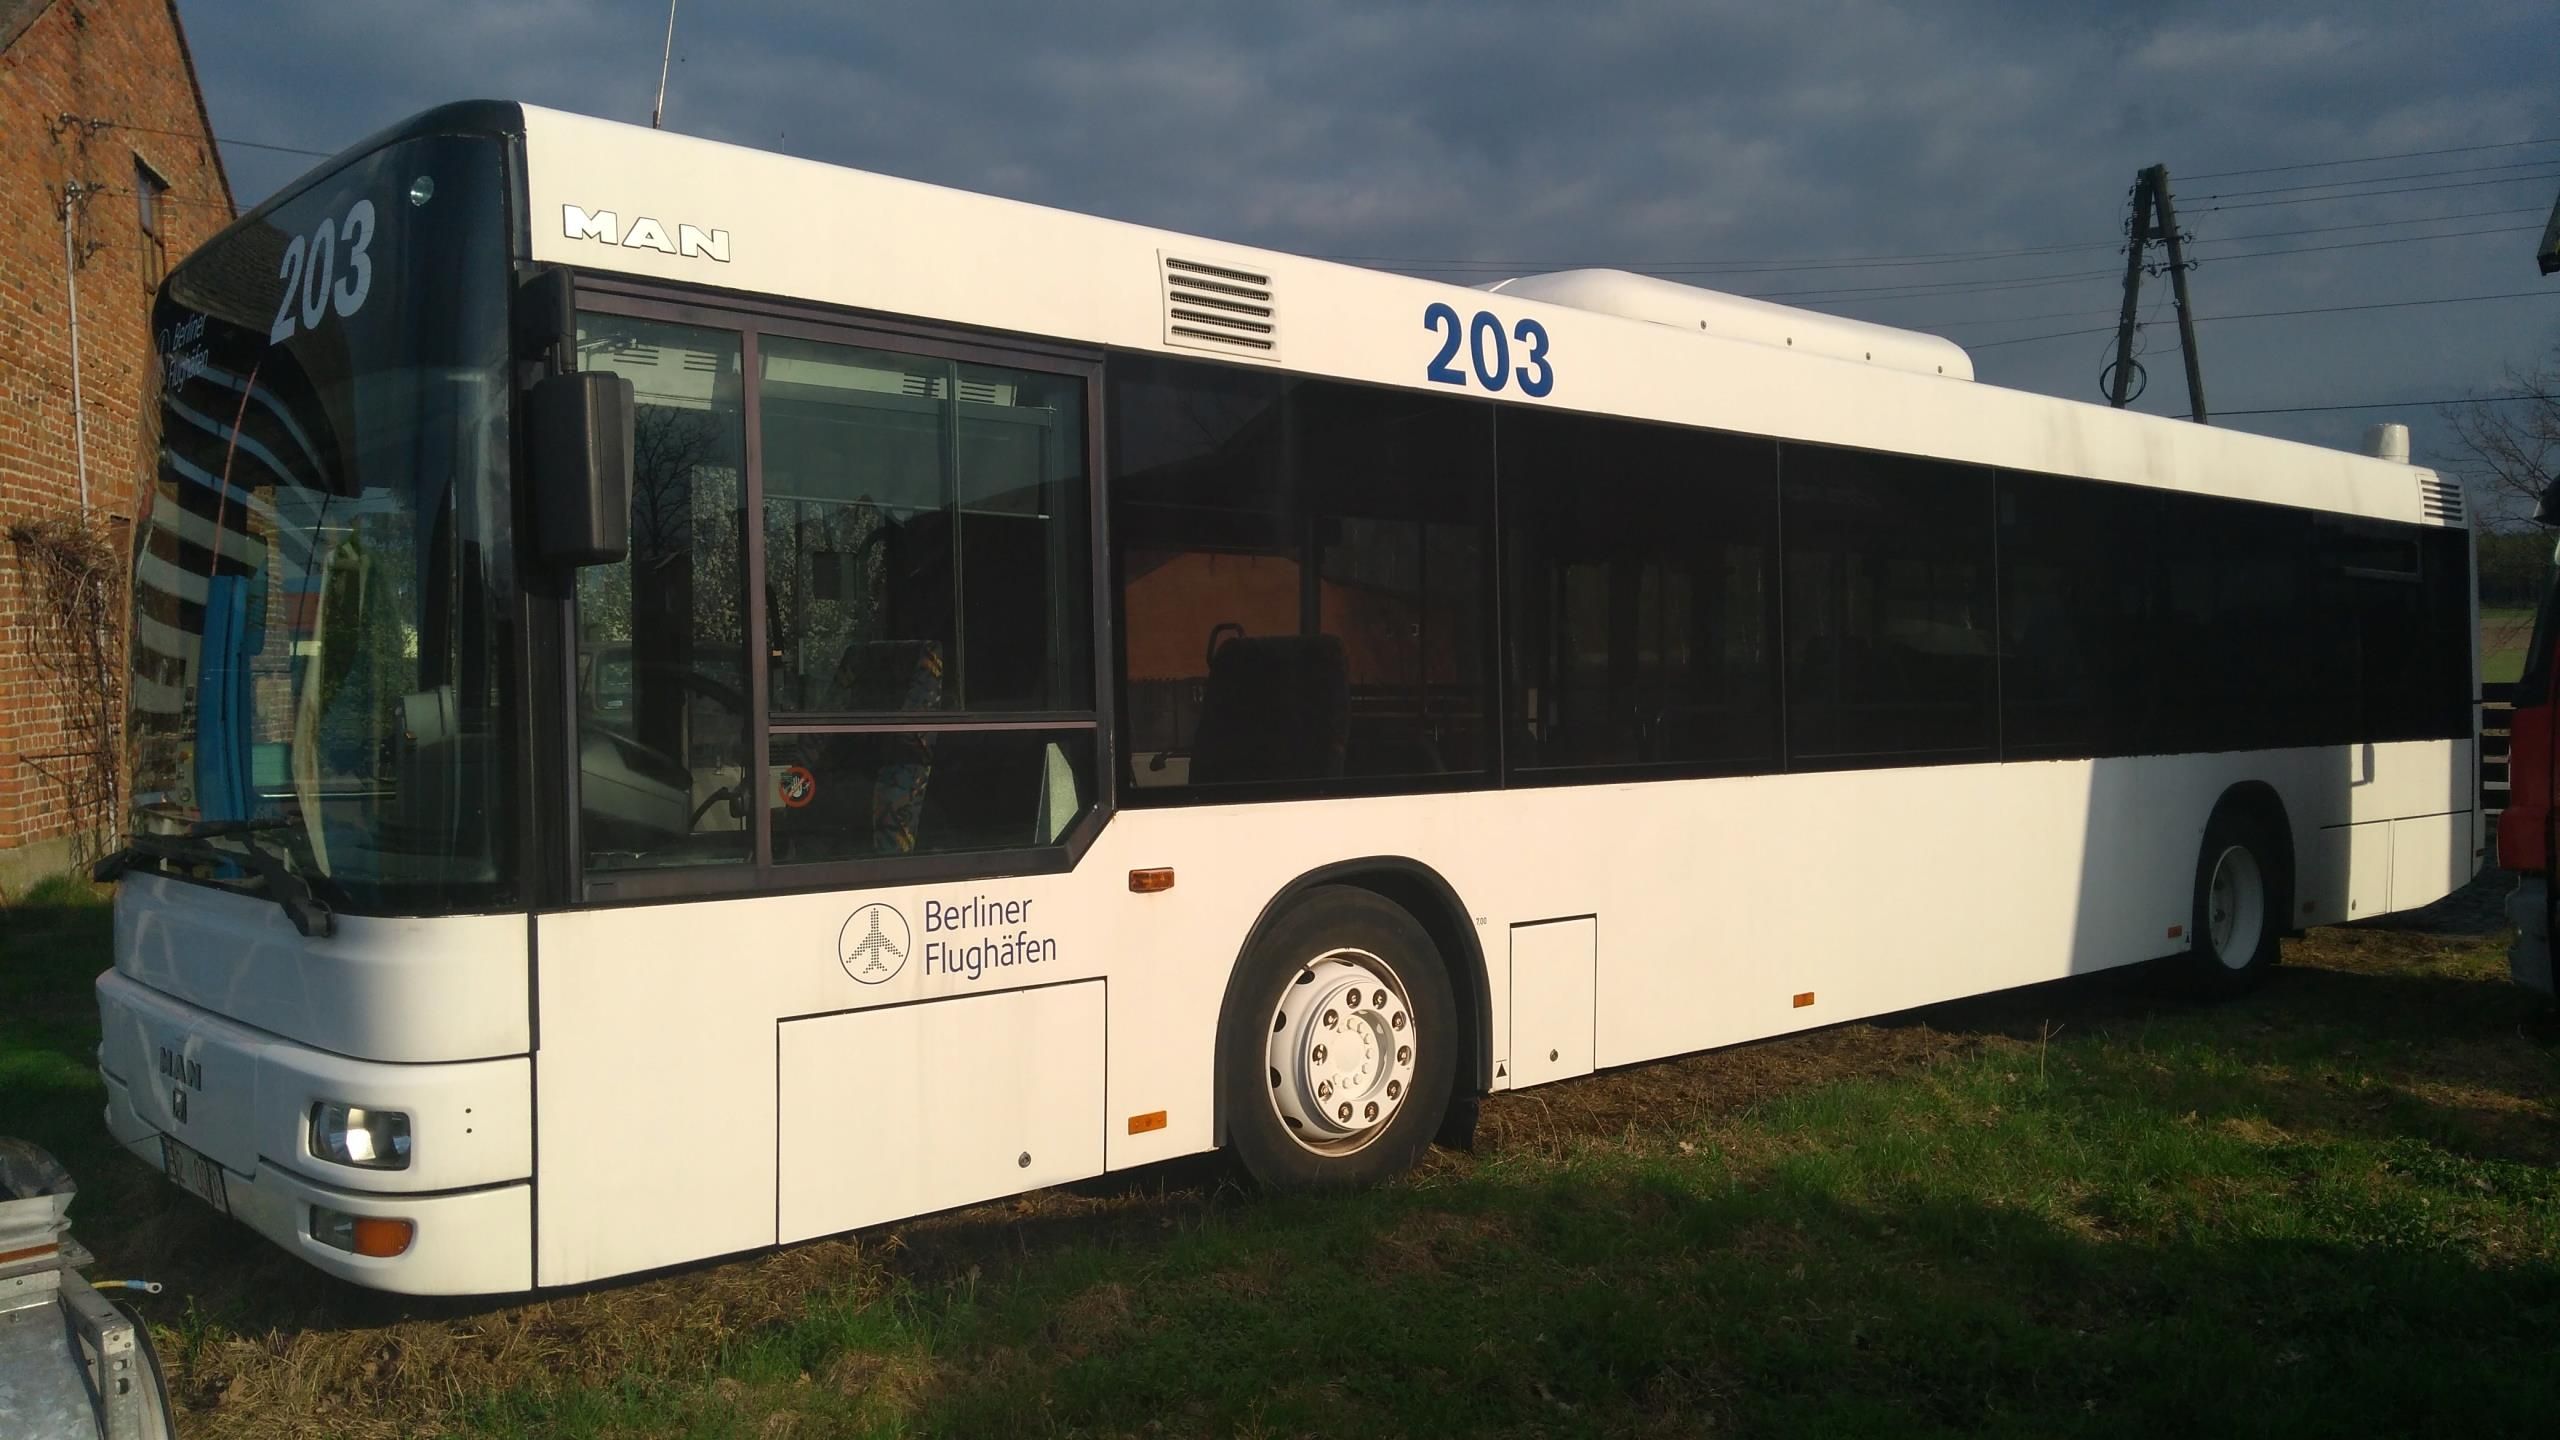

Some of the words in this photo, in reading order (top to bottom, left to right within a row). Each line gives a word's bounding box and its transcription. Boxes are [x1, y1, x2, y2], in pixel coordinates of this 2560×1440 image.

[562, 203, 731, 263] MAN
[270, 199, 375, 345] 203
[1424, 302, 1554, 398] 203
[925, 895, 1033, 933] Berliner
[925, 930, 1057, 980] Flughäfen
[159, 1046, 202, 1091] MAN
